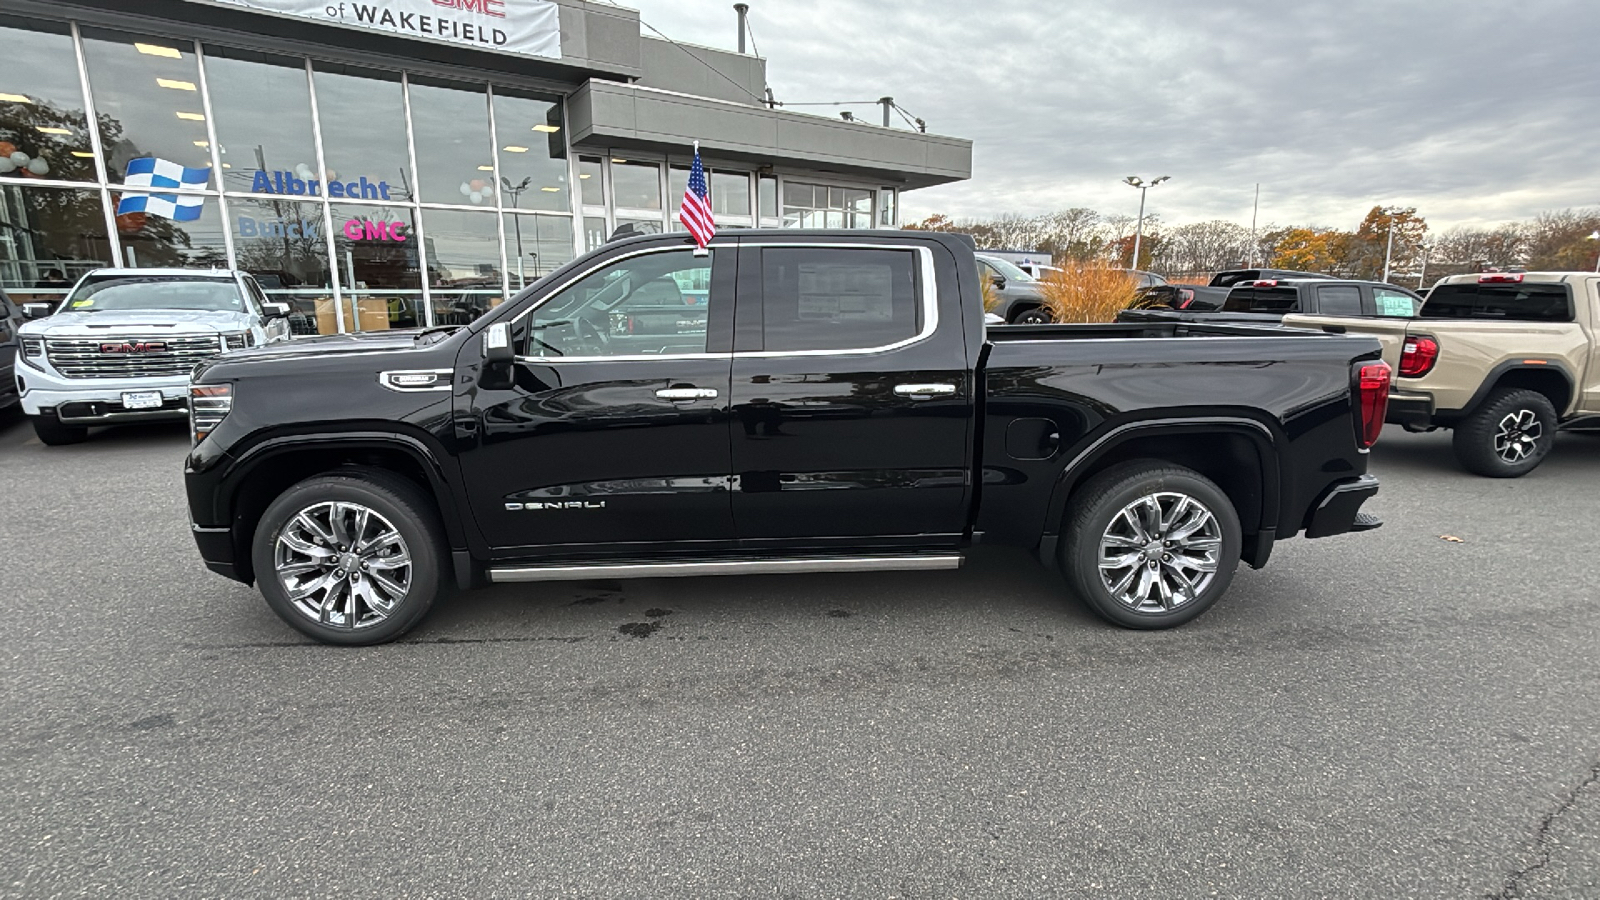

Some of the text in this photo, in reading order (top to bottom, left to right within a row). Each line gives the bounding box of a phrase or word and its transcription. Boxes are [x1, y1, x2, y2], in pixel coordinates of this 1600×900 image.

[326, 2, 508, 46] of WAKEFIELD
[251, 170, 392, 201] Albrecht
[238, 216, 320, 240] Buick
[344, 220, 407, 242] GMC
[101, 342, 166, 353] GMC
[504, 501, 607, 511] DENALI
